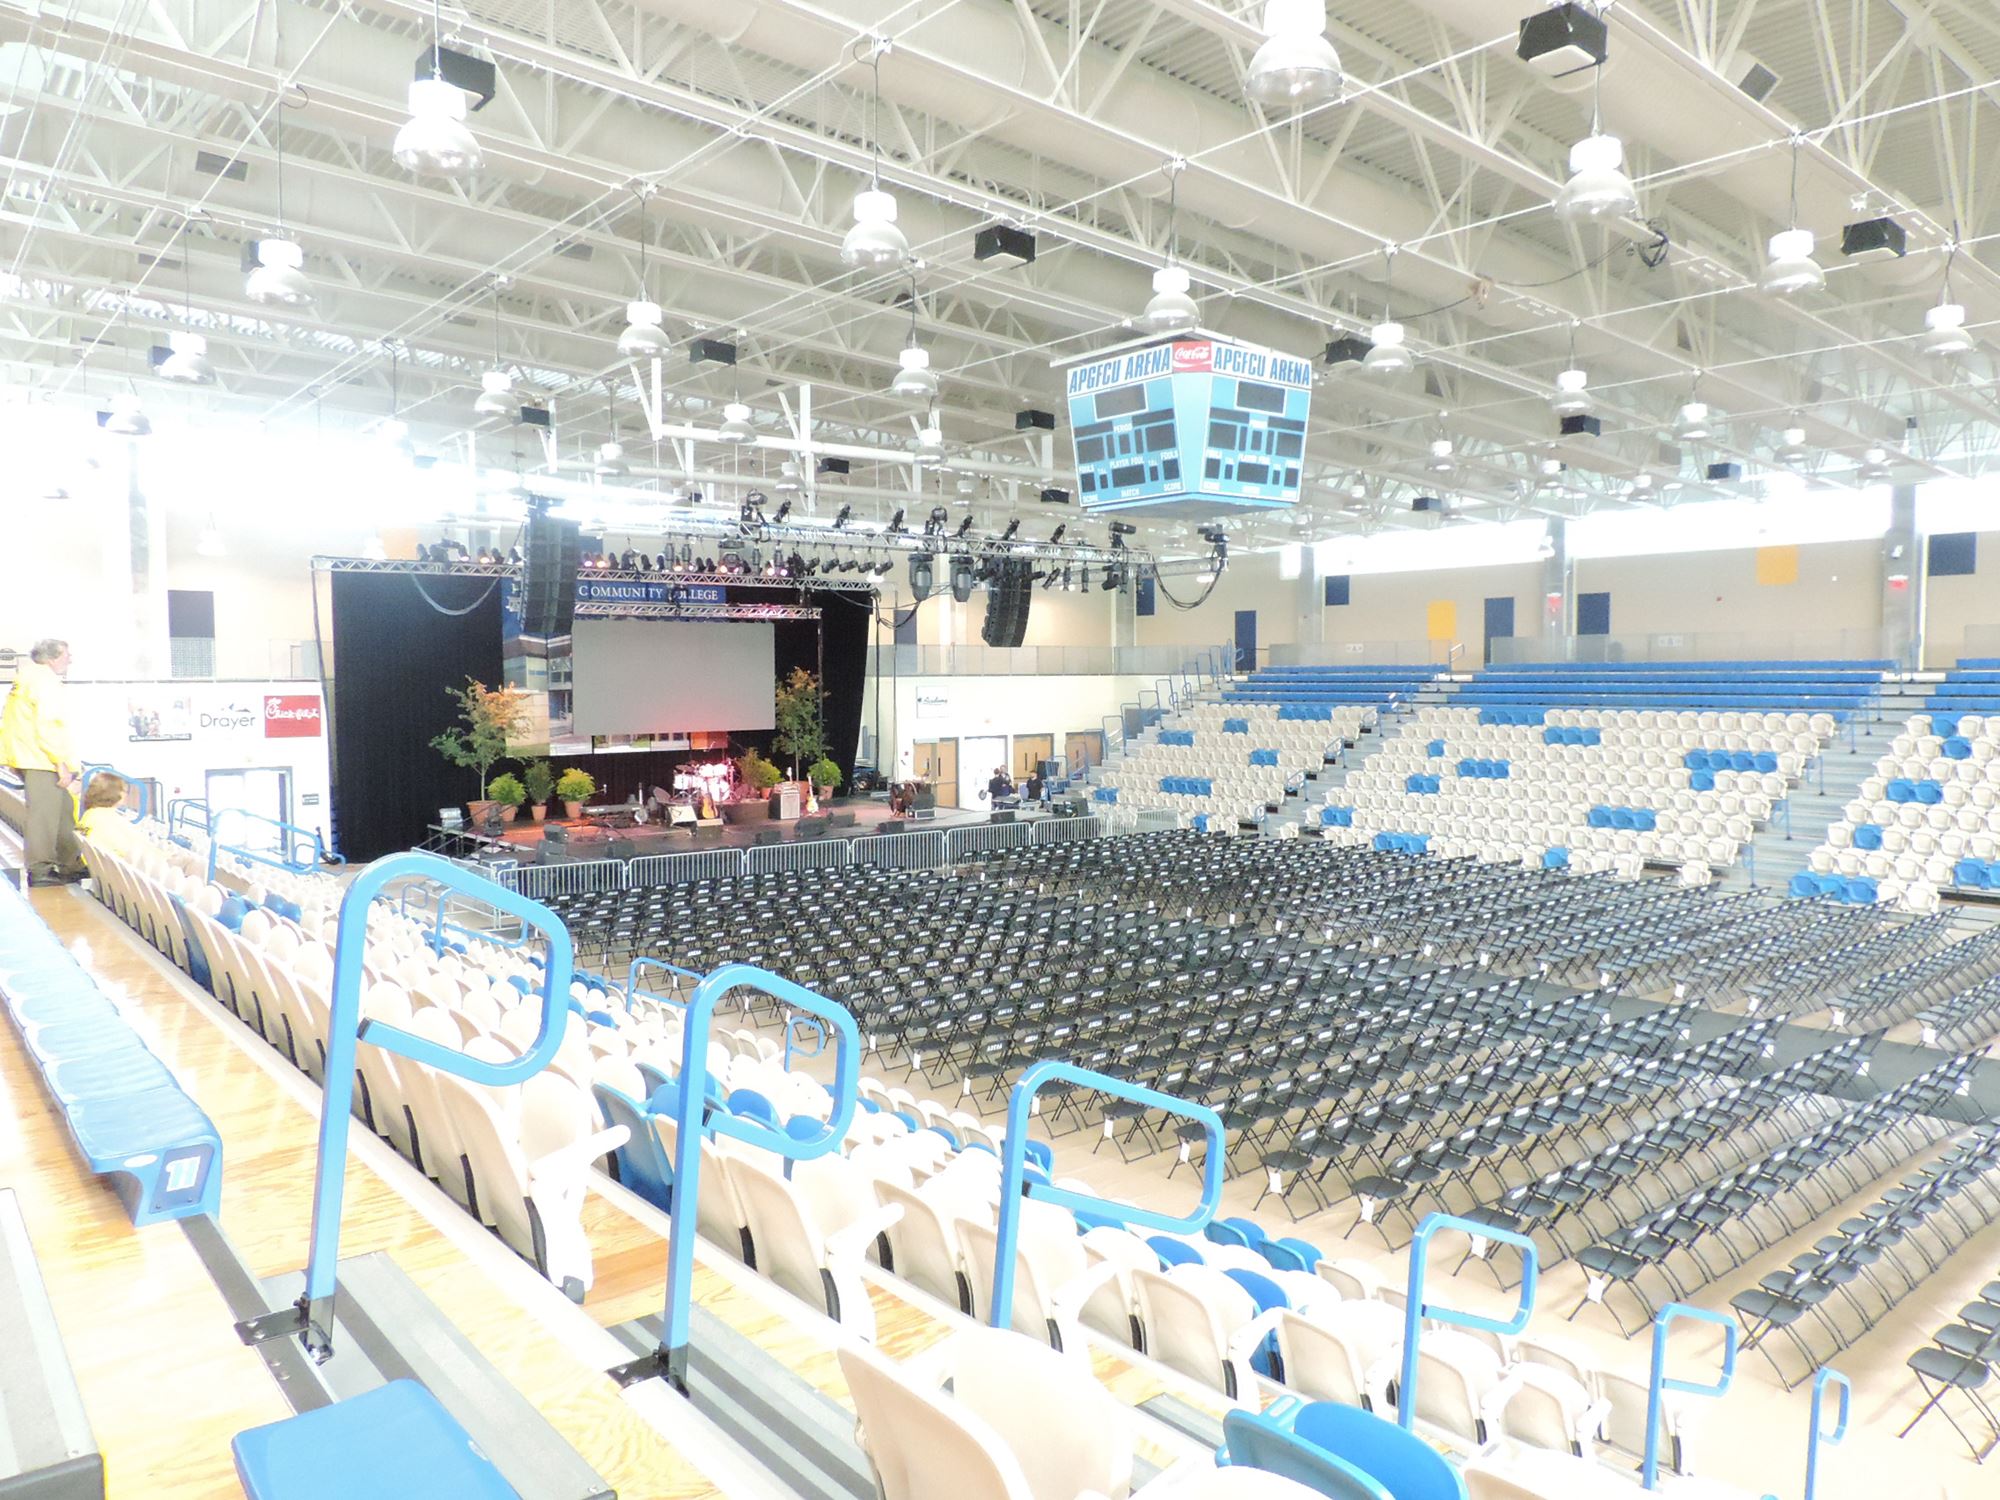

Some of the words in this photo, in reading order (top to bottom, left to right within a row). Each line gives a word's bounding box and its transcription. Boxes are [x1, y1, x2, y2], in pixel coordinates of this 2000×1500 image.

[1175, 345, 1210, 358] Coca-Cola
[1069, 360, 1120, 394] APGFCU
[1125, 347, 1171, 380] ARENA
[1213, 347, 1266, 377] APGFCU
[1270, 358, 1310, 386] ARENA
[1113, 423, 1133, 433] PERIOD
[1160, 450, 1178, 461] FOULS
[1109, 458, 1129, 469] PLAYER
[578, 585, 663, 599] COMMUNITY
[667, 588, 718, 600] OLLEGE
[200, 713, 256, 730] Drayer
